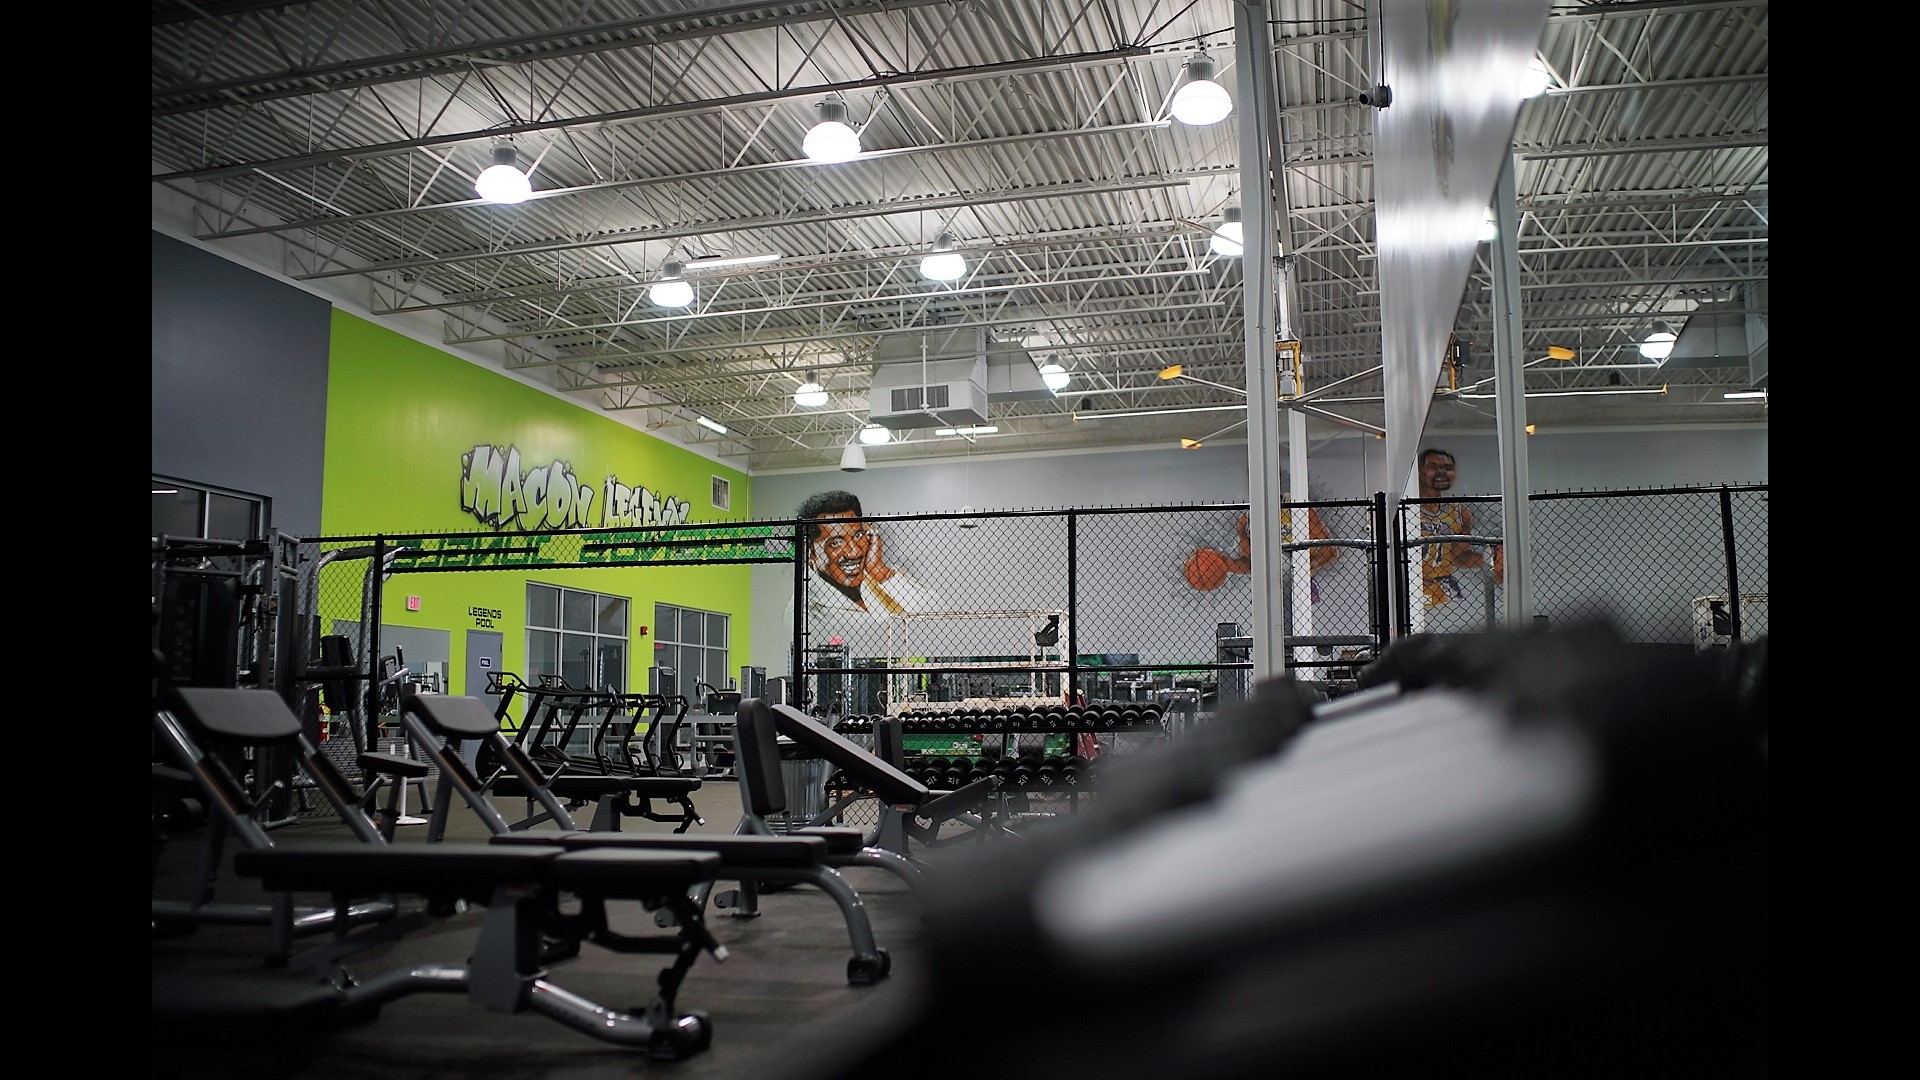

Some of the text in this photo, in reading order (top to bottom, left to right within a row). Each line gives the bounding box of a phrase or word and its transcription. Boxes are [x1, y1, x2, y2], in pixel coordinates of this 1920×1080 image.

[461, 444, 595, 532] MACON
[468, 606, 502, 619] LEGENDS
[475, 618, 494, 628] POOL
